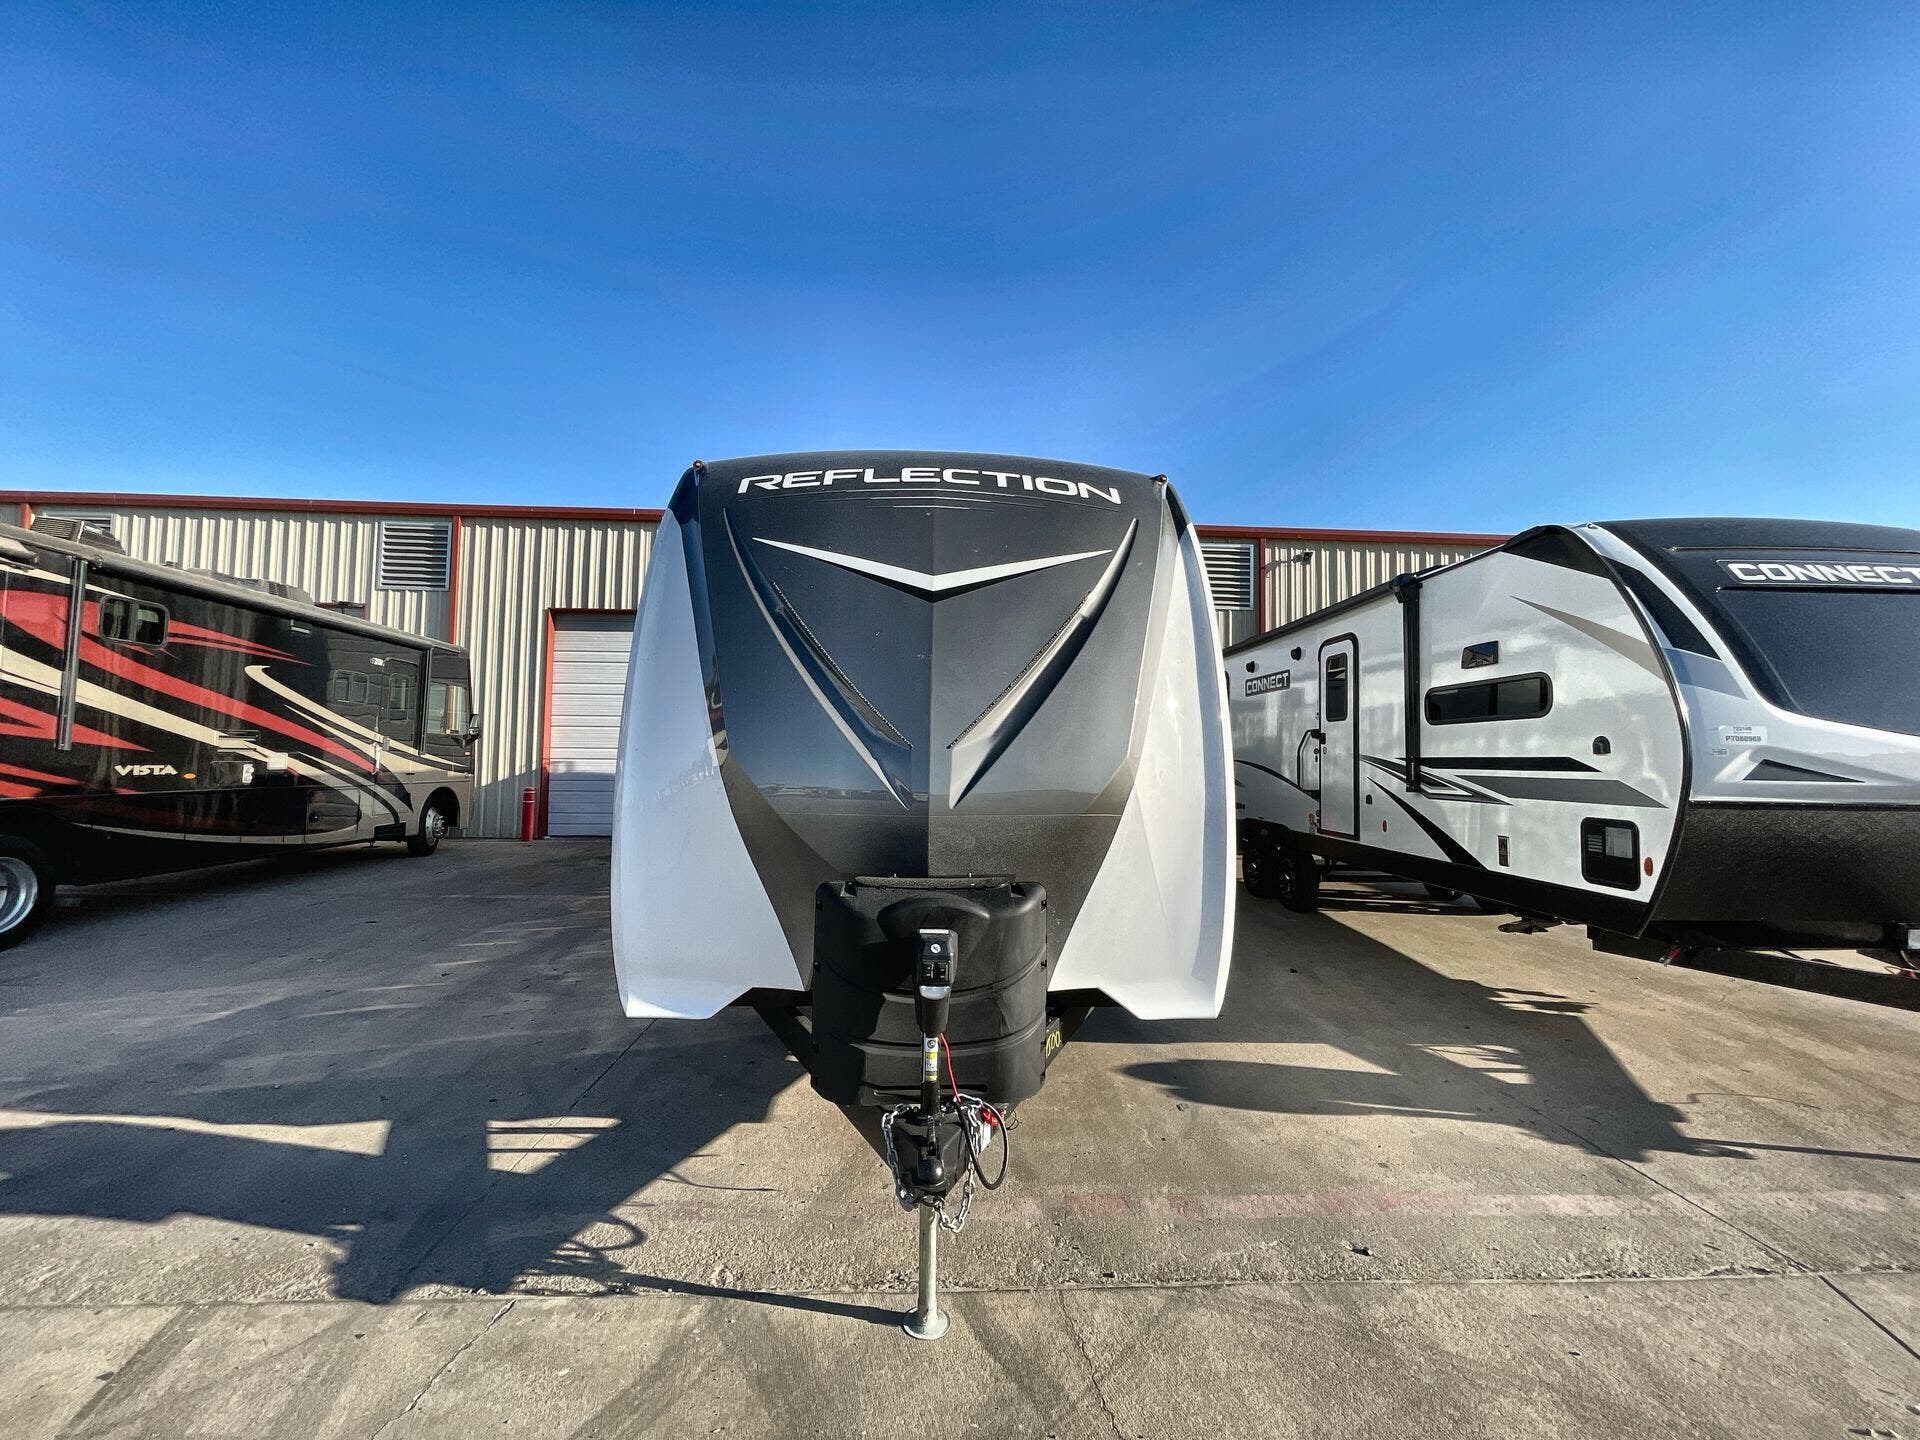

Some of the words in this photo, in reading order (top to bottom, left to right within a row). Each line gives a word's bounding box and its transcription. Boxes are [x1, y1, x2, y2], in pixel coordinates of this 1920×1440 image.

[737, 467, 1122, 505] REFLECTION
[1246, 672, 1289, 694] CONNECT
[114, 764, 179, 776] VISTA
